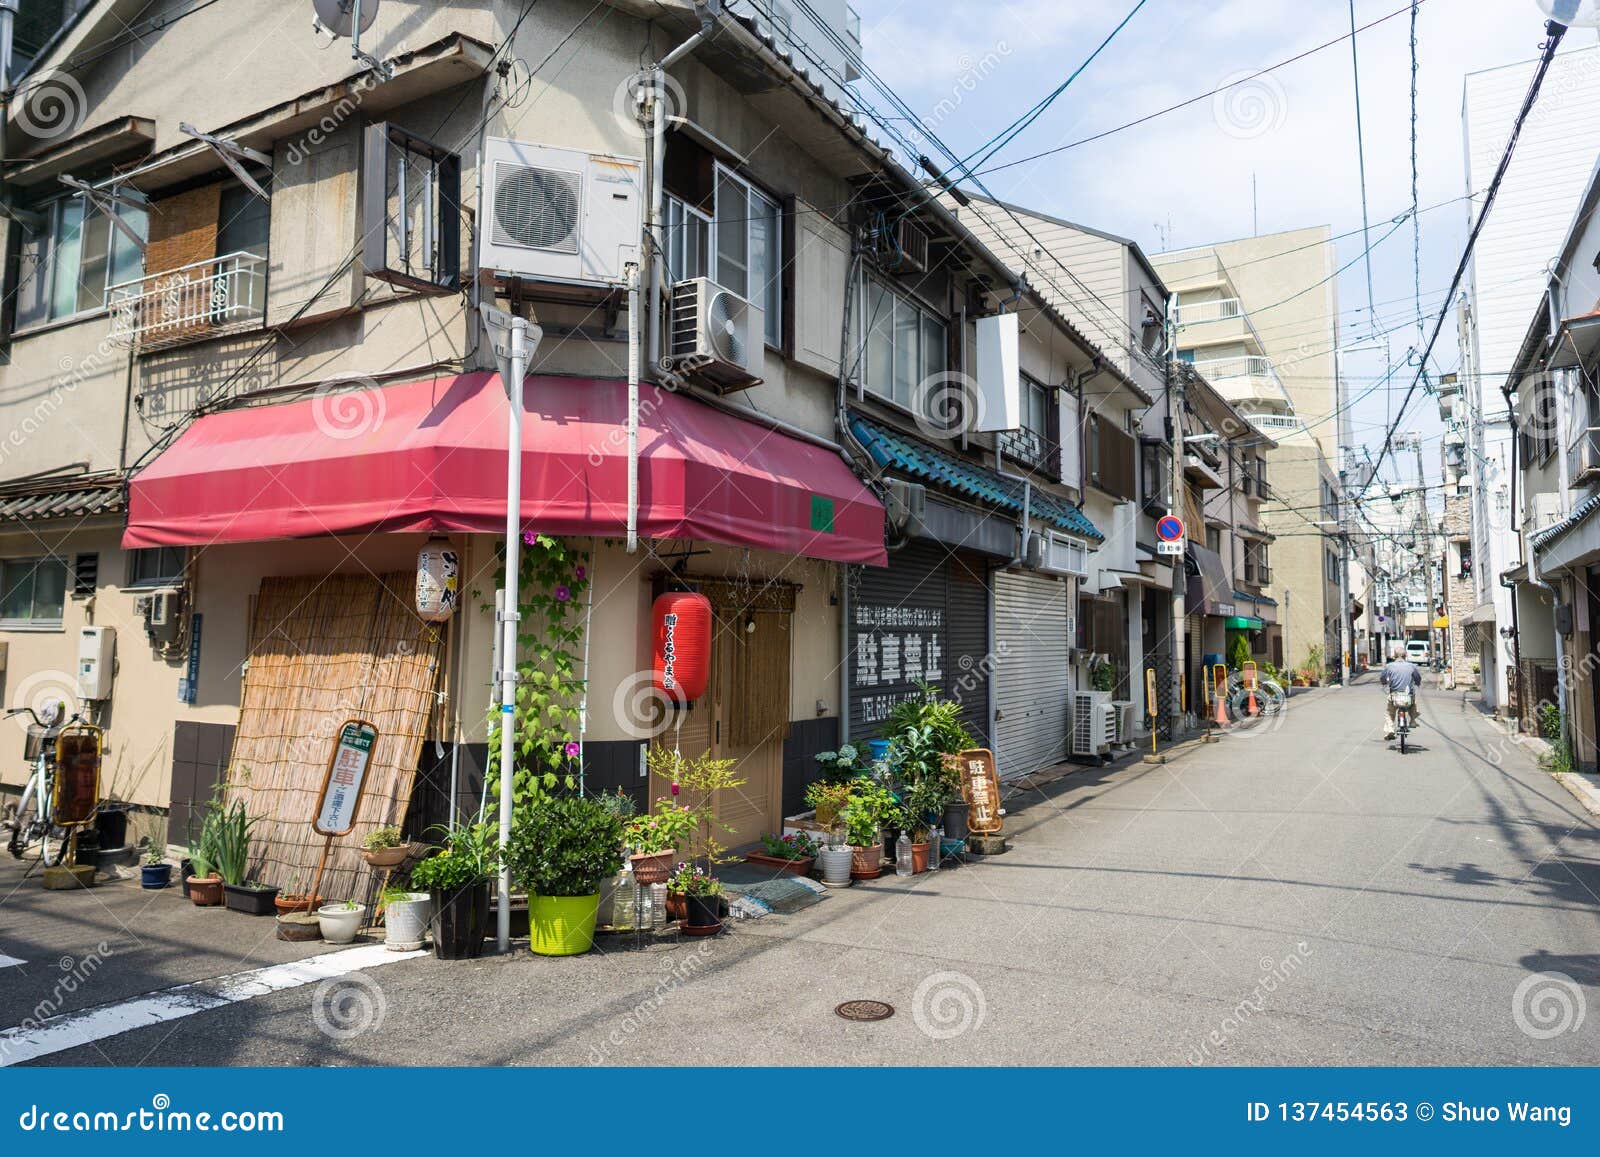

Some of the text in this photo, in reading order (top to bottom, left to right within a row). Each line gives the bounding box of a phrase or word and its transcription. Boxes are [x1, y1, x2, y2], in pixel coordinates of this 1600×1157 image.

[856, 633, 942, 686] 駐車禁止
[968, 759, 993, 822] 駐車禁止
